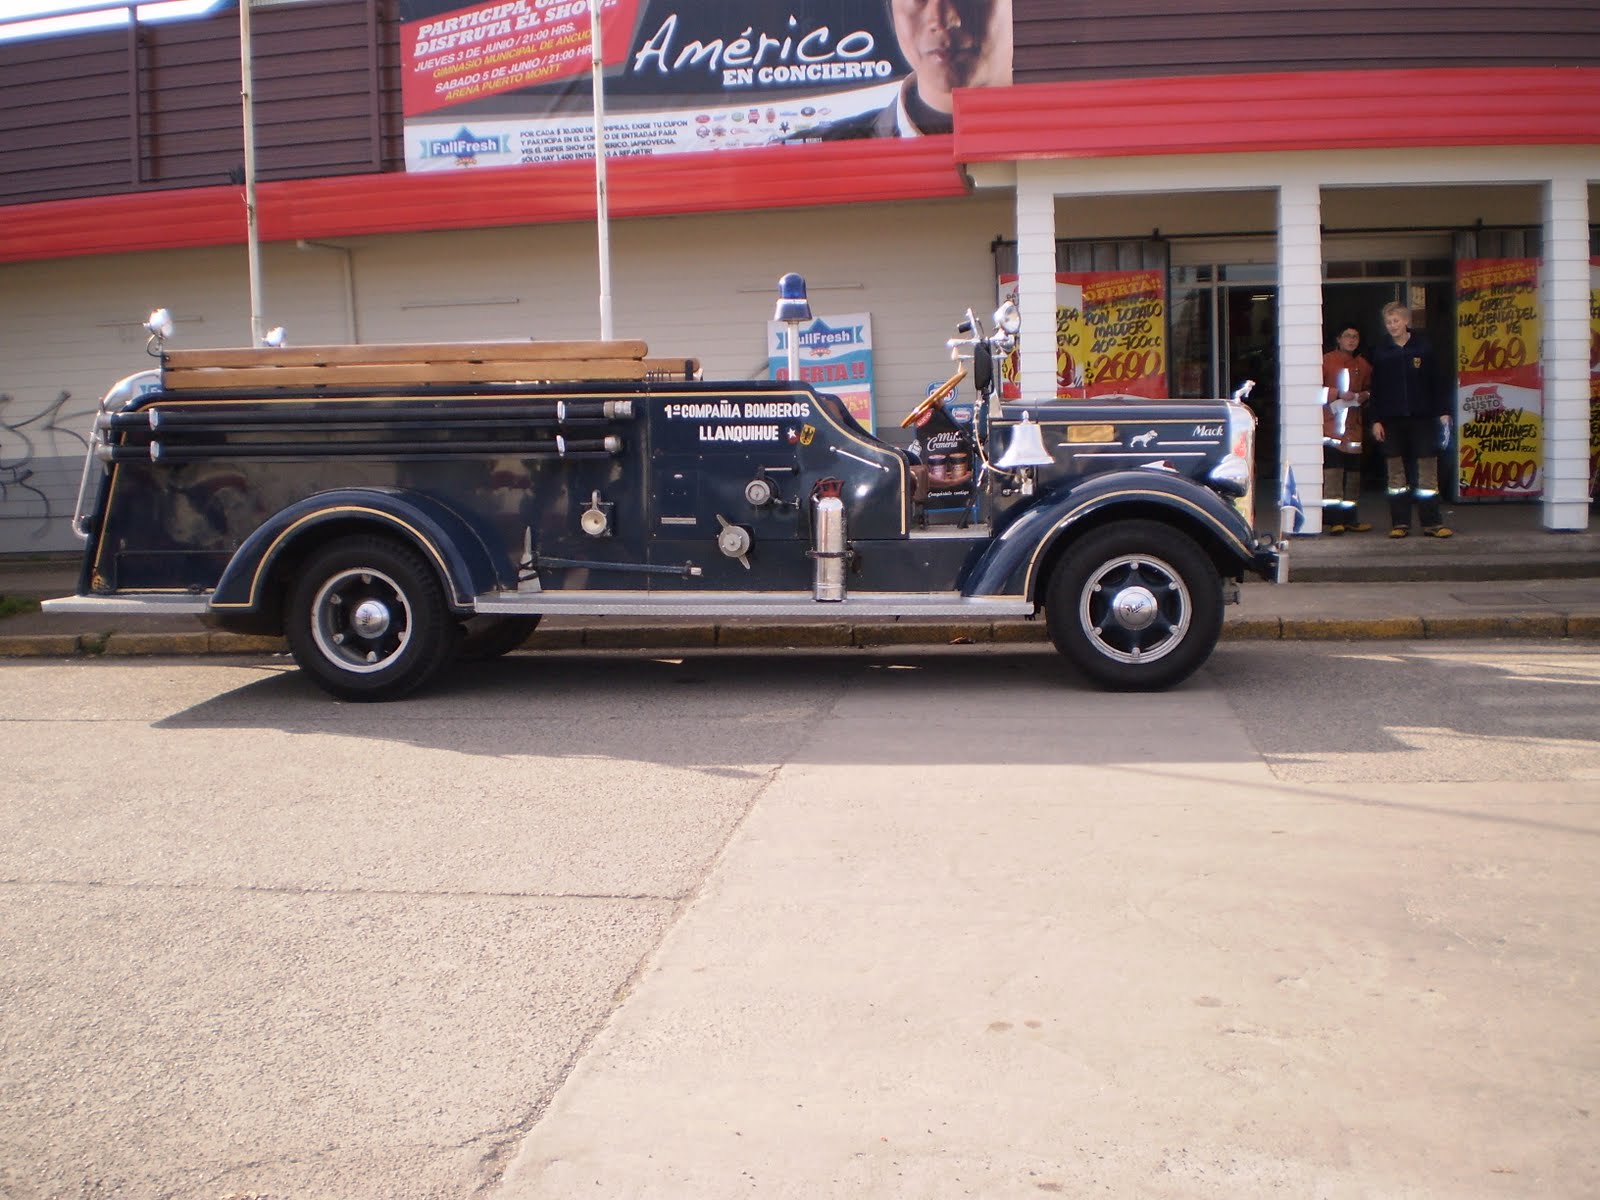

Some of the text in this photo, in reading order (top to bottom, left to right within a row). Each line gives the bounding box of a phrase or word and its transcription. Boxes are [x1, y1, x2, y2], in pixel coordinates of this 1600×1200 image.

[417, 0, 532, 39] PARTICIPA,
[414, 18, 511, 57] DISFRUTA
[515, 12, 540, 30] EL
[634, 13, 874, 72] Américo
[414, 53, 455, 72] JUEVES
[457, 51, 464, 61] 3
[465, 46, 481, 59] DE
[483, 37, 515, 54] JUNIO
[522, 29, 549, 44] 21:00
[551, 22, 576, 36] HRS.
[433, 57, 482, 78] GIMNASIO
[484, 44, 537, 65] MUNICIPAL
[540, 38, 555, 50] DE
[435, 73, 480, 93] SABADO
[482, 70, 490, 81] 5
[491, 66, 507, 79] DE
[508, 57, 541, 74] JUNIO
[548, 49, 575, 64] 21:00
[577, 43, 593, 56] HR
[723, 60, 892, 86] EN CONCIERTO
[445, 63, 562, 101] ARENA PUERTO MONTT
[632, 122, 651, 130] EXIGE
[653, 121, 662, 129] TU
[432, 139, 497, 155] FullFresh
[527, 137, 562, 146] PARTICIPA
[622, 130, 657, 139] ENTRADAS
[658, 129, 677, 137] PARA
[535, 146, 543, 154] EL
[544, 145, 564, 153] SUPER
[565, 143, 586, 152] SHOW
[587, 142, 595, 150] DE
[798, 330, 850, 345] ullFresh
[1094, 350, 1162, 383] 2690
[1469, 337, 1526, 373] 469
[776, 363, 848, 383] OERTA
[744, 402, 810, 418] BOMBEROS
[1463, 399, 1500, 411] GUSTO
[699, 425, 779, 442] LLANQUIHUE
[1192, 425, 1224, 437] Mack
